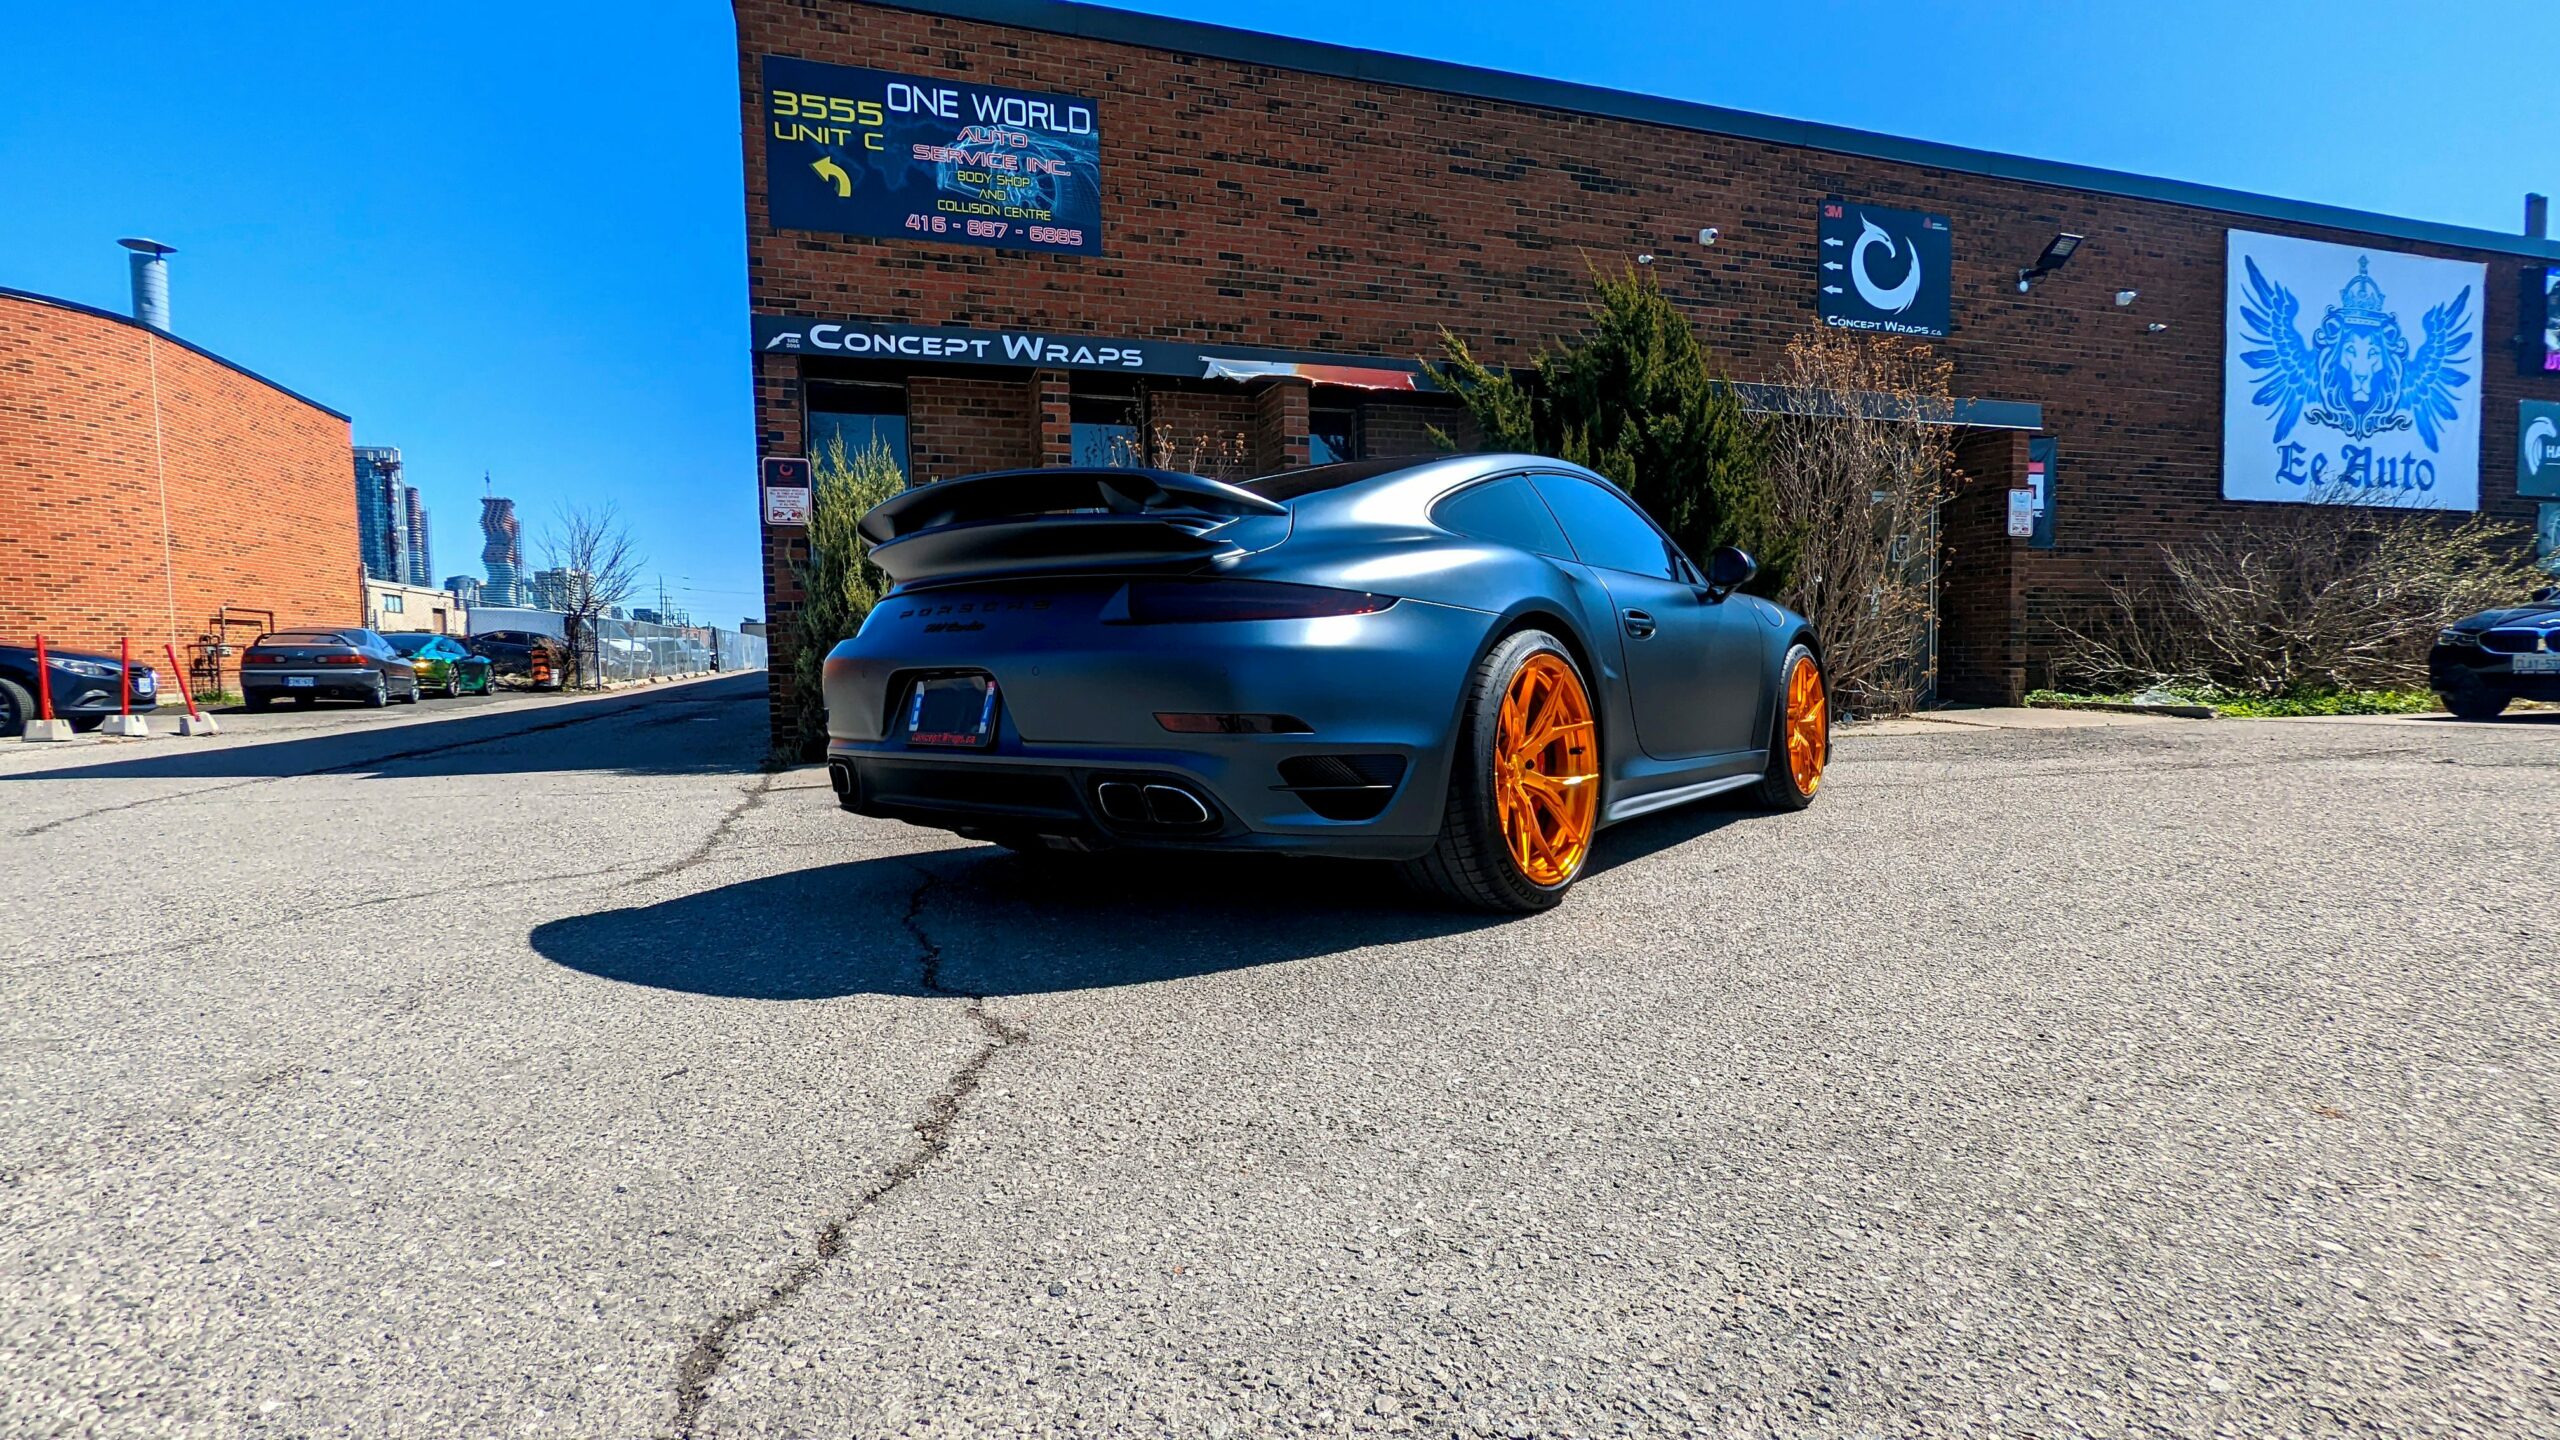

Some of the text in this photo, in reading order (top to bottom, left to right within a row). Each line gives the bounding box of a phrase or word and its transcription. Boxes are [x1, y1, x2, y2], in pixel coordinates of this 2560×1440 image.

[773, 90, 884, 126] 3555
[887, 83, 1091, 135] ONE WORLD
[774, 121, 884, 151] UNIT C
[957, 126, 1028, 148] AUTO
[912, 143, 1072, 177] SERVICE INC.
[957, 170, 1030, 187] BODY SHOP
[978, 188, 1006, 200] AND
[937, 199, 1051, 221] COLLISION CENTRE
[1824, 204, 1843, 219] 3M
[905, 213, 947, 233] 416
[967, 219, 1008, 239] 887
[1029, 225, 1083, 246] 6885
[2275, 441, 2436, 492] Ee Auto
